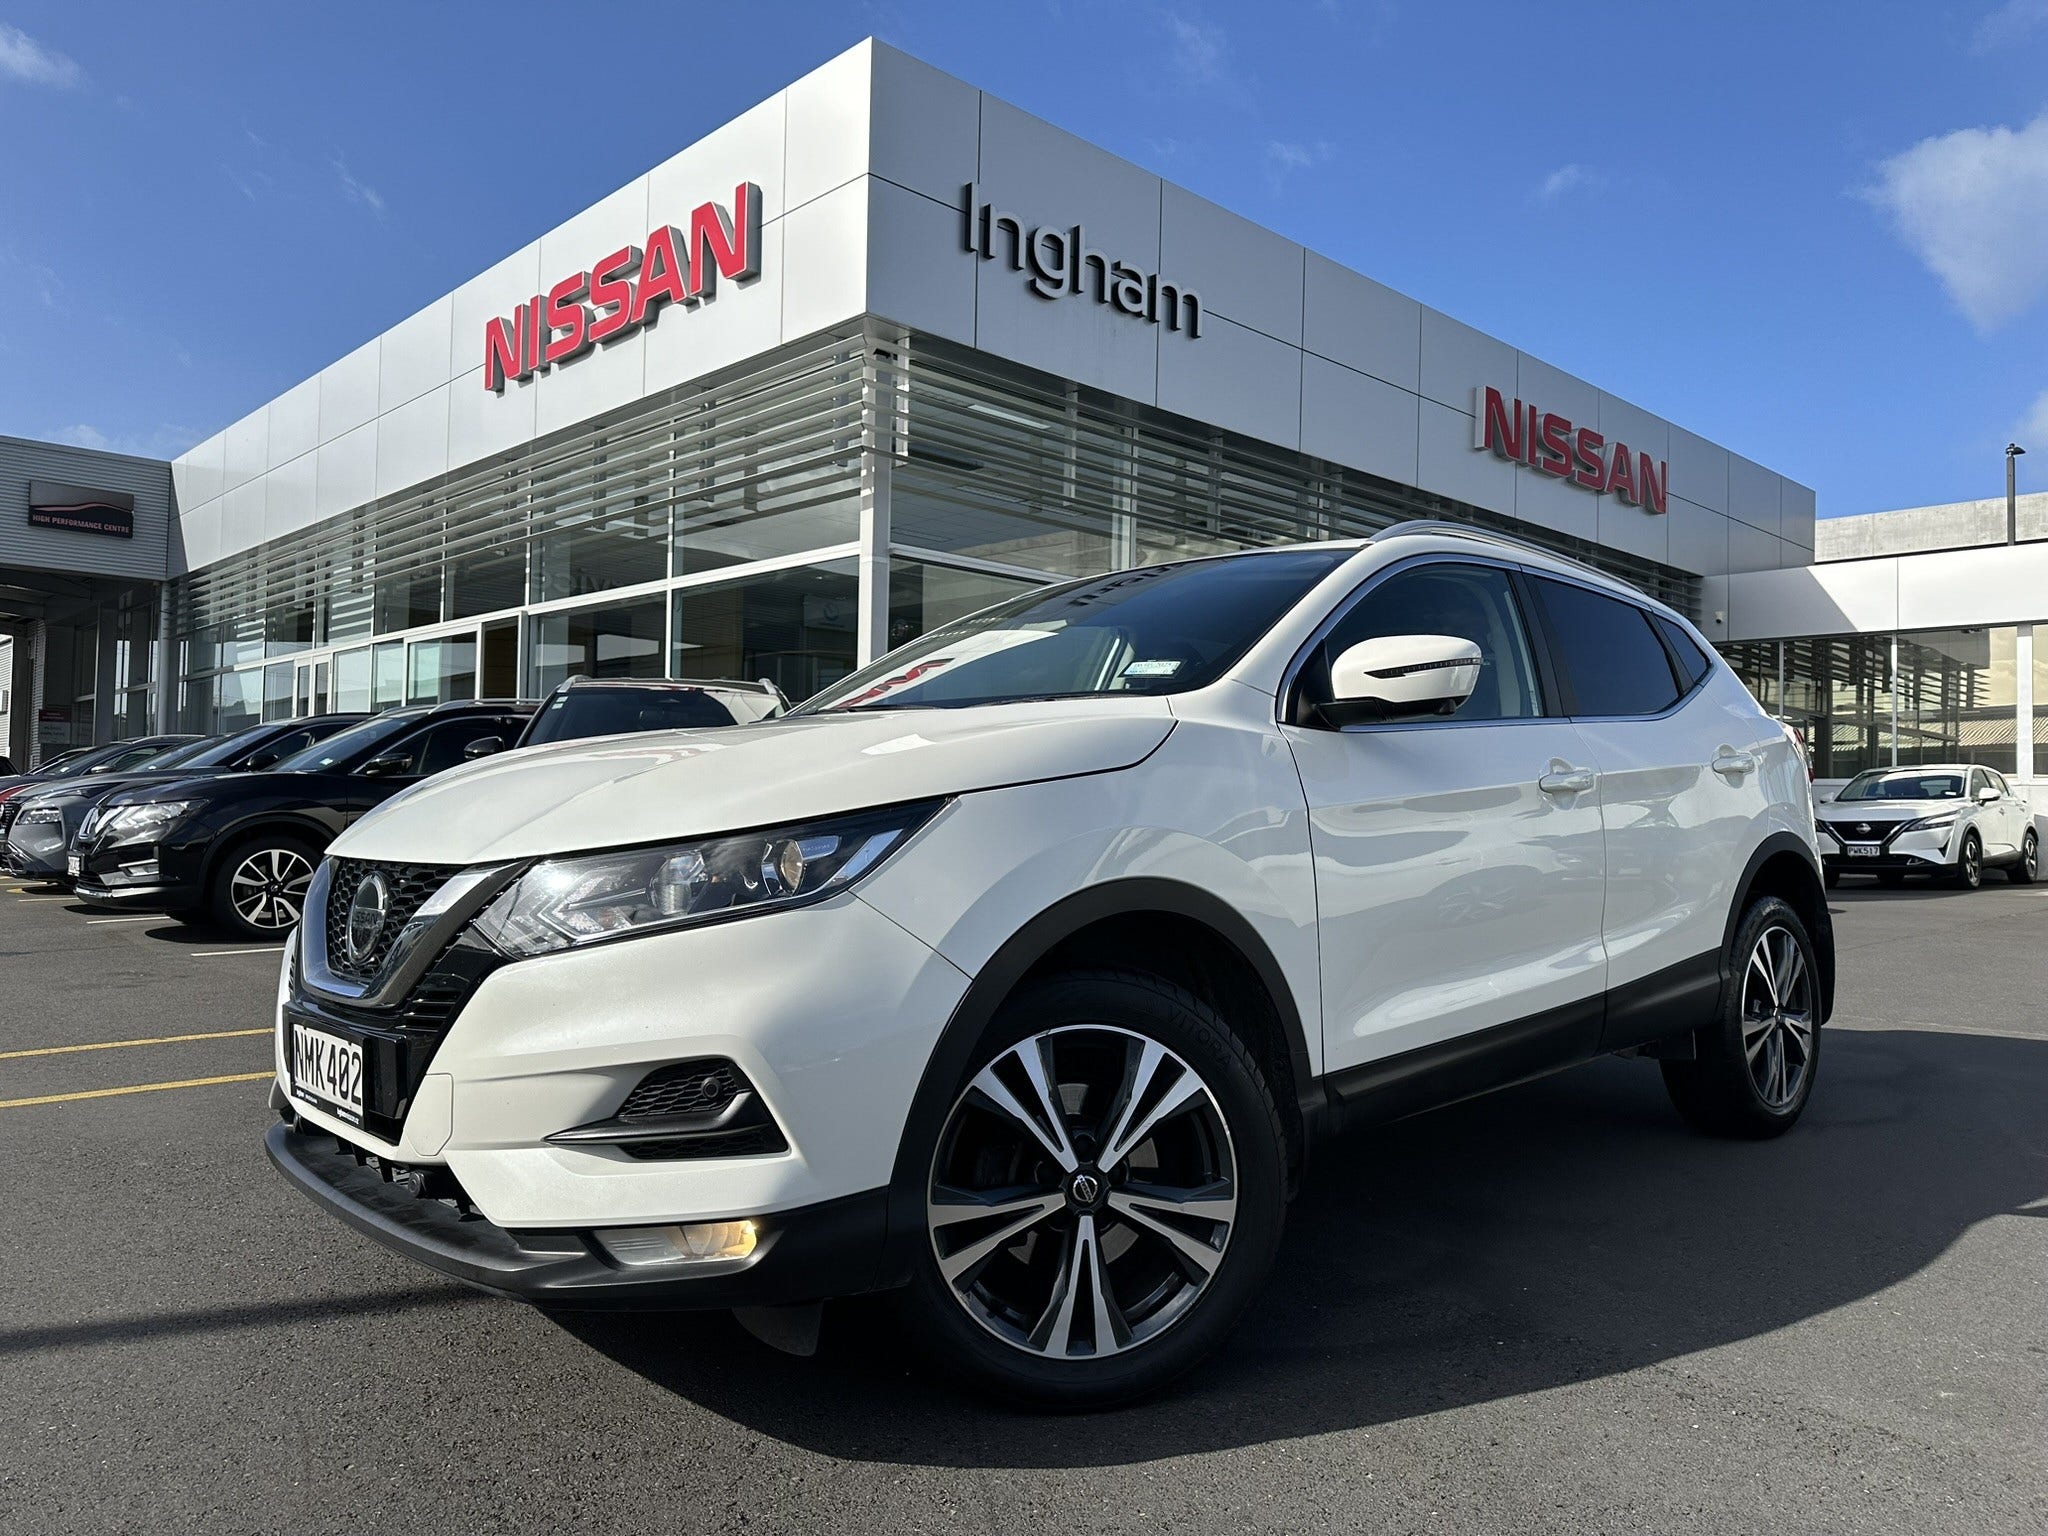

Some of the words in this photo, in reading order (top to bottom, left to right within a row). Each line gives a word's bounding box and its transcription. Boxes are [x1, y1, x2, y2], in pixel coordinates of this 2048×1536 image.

[485, 181, 759, 392] NISSAN
[960, 181, 1202, 339] Ingham
[1474, 386, 1667, 514] NISSAN
[32, 514, 50, 523] HIGH
[52, 517, 102, 530] PERFORMANCE
[104, 523, 130, 534] CENTRE
[294, 1030, 362, 1107] NMK402
